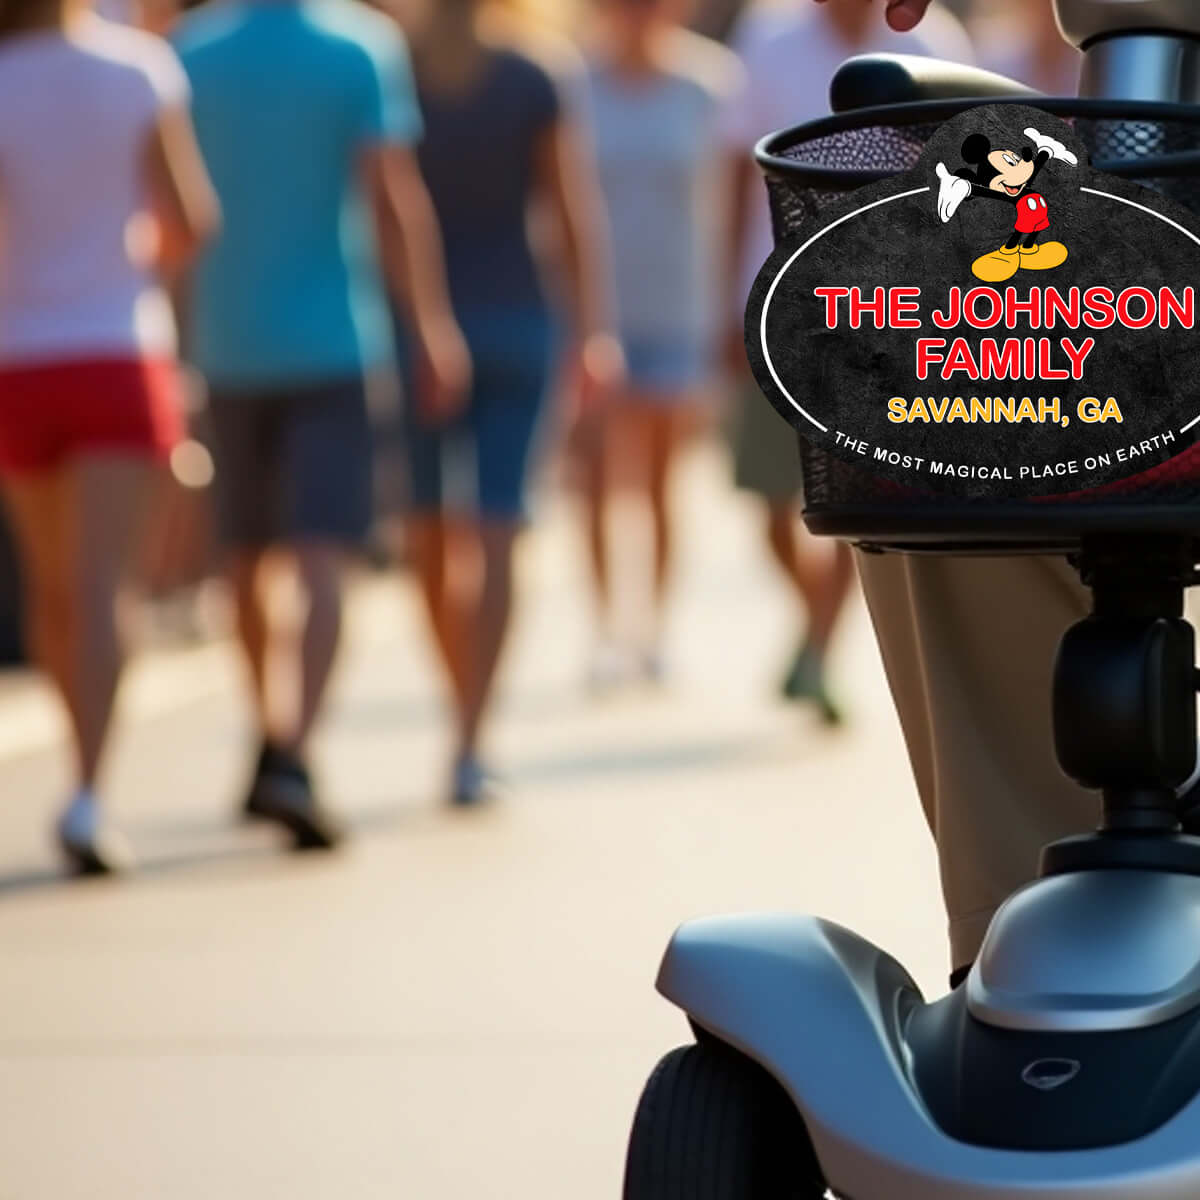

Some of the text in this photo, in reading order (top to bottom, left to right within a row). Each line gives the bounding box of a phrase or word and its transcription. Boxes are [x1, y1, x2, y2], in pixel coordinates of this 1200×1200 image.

[814, 287, 1194, 329] THE JOHNSON
[916, 337, 1095, 380] FAMILY
[888, 397, 1123, 427] SAVANNAH, GA
[835, 431, 1175, 479] THE MOST MAGICAL PLACE ON EARTH
